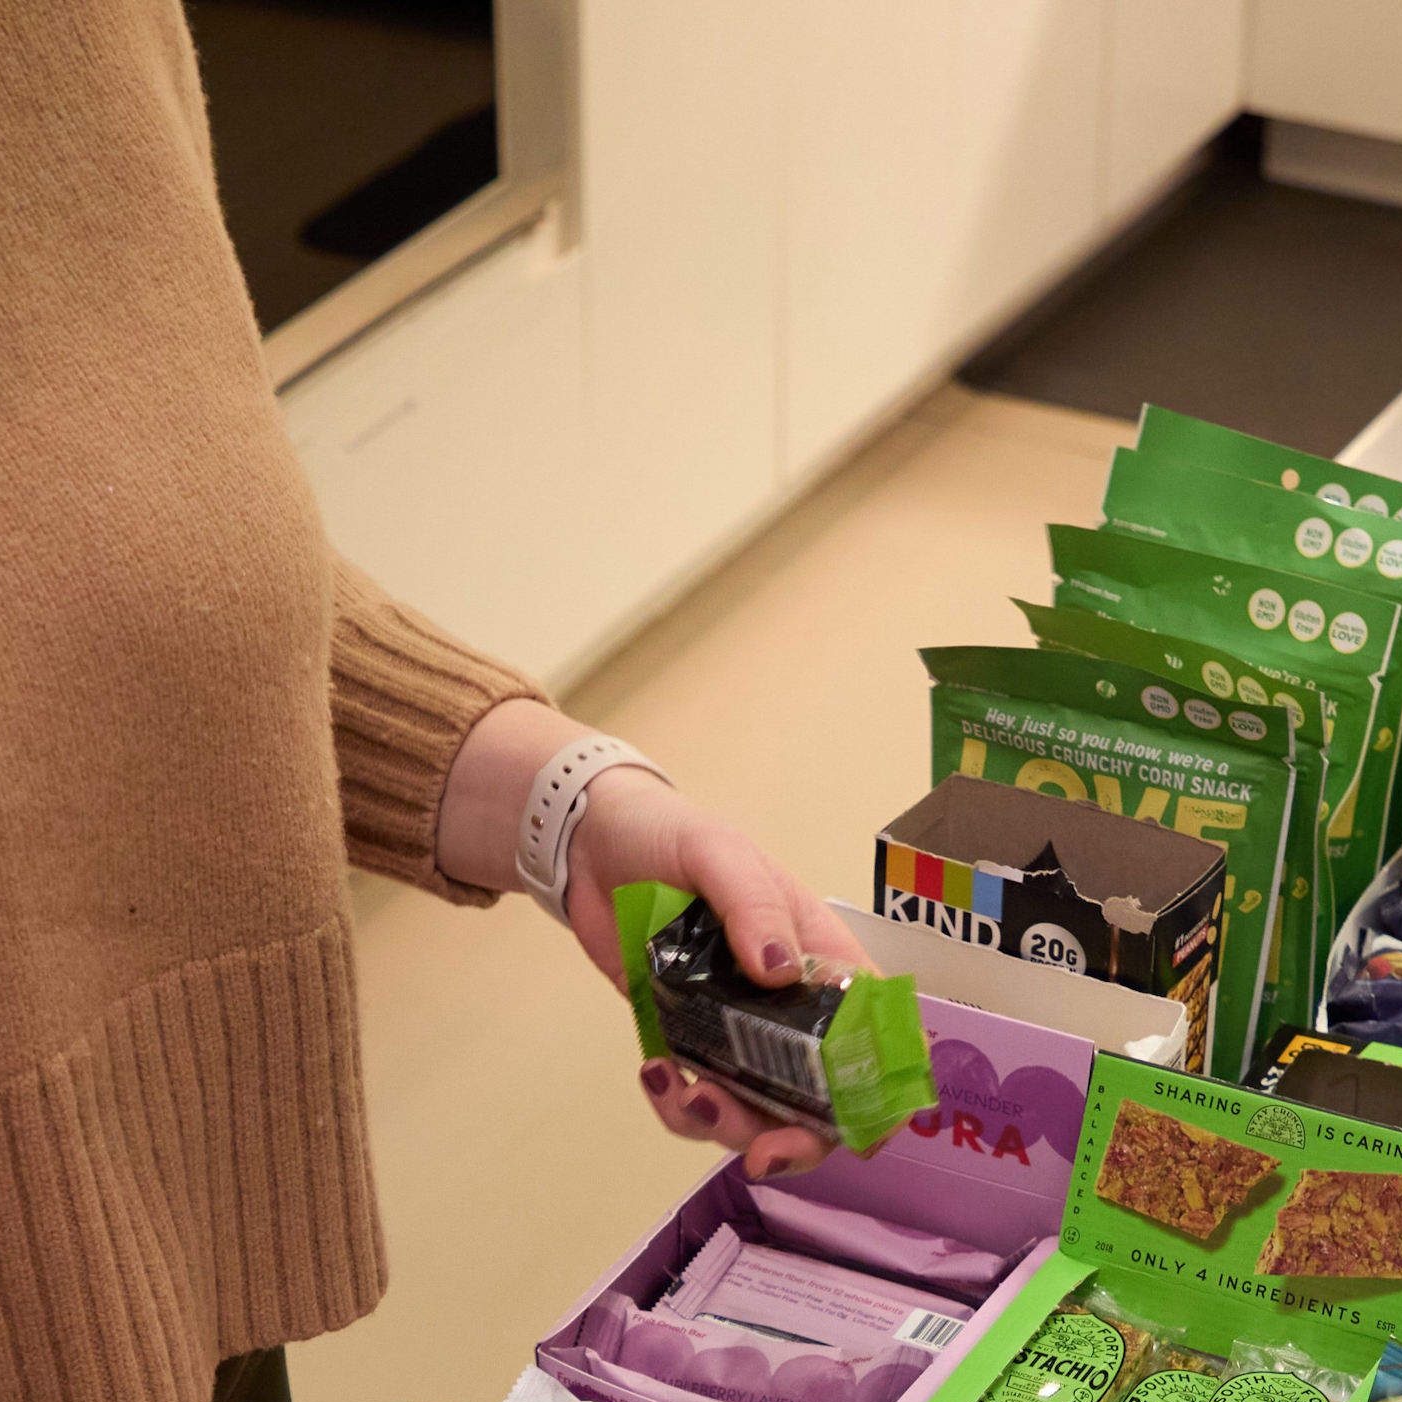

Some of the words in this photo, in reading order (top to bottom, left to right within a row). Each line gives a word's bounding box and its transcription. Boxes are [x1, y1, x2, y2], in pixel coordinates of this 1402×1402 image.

[961, 719, 1047, 758] DELICIOUS
[1052, 740, 1134, 778] CRUNCHY
[1137, 764, 1185, 792] CORN
[1190, 776, 1253, 802] SNACK
[1021, 715, 1054, 737] just
[1056, 724, 1076, 742] so
[1078, 727, 1111, 751] you
[1167, 743, 1211, 768] we're
[1216, 761, 1229, 776] a
[883, 885, 1002, 951] KIND
[1030, 934, 1078, 966] 20G
[1154, 1081, 1243, 1116] SHARING
[1316, 1123, 1335, 1140] IS
[1130, 1248, 1186, 1275] ONLY
[1196, 1268, 1207, 1282] 4
[1219, 1273, 1362, 1326] INGREDIENTS
